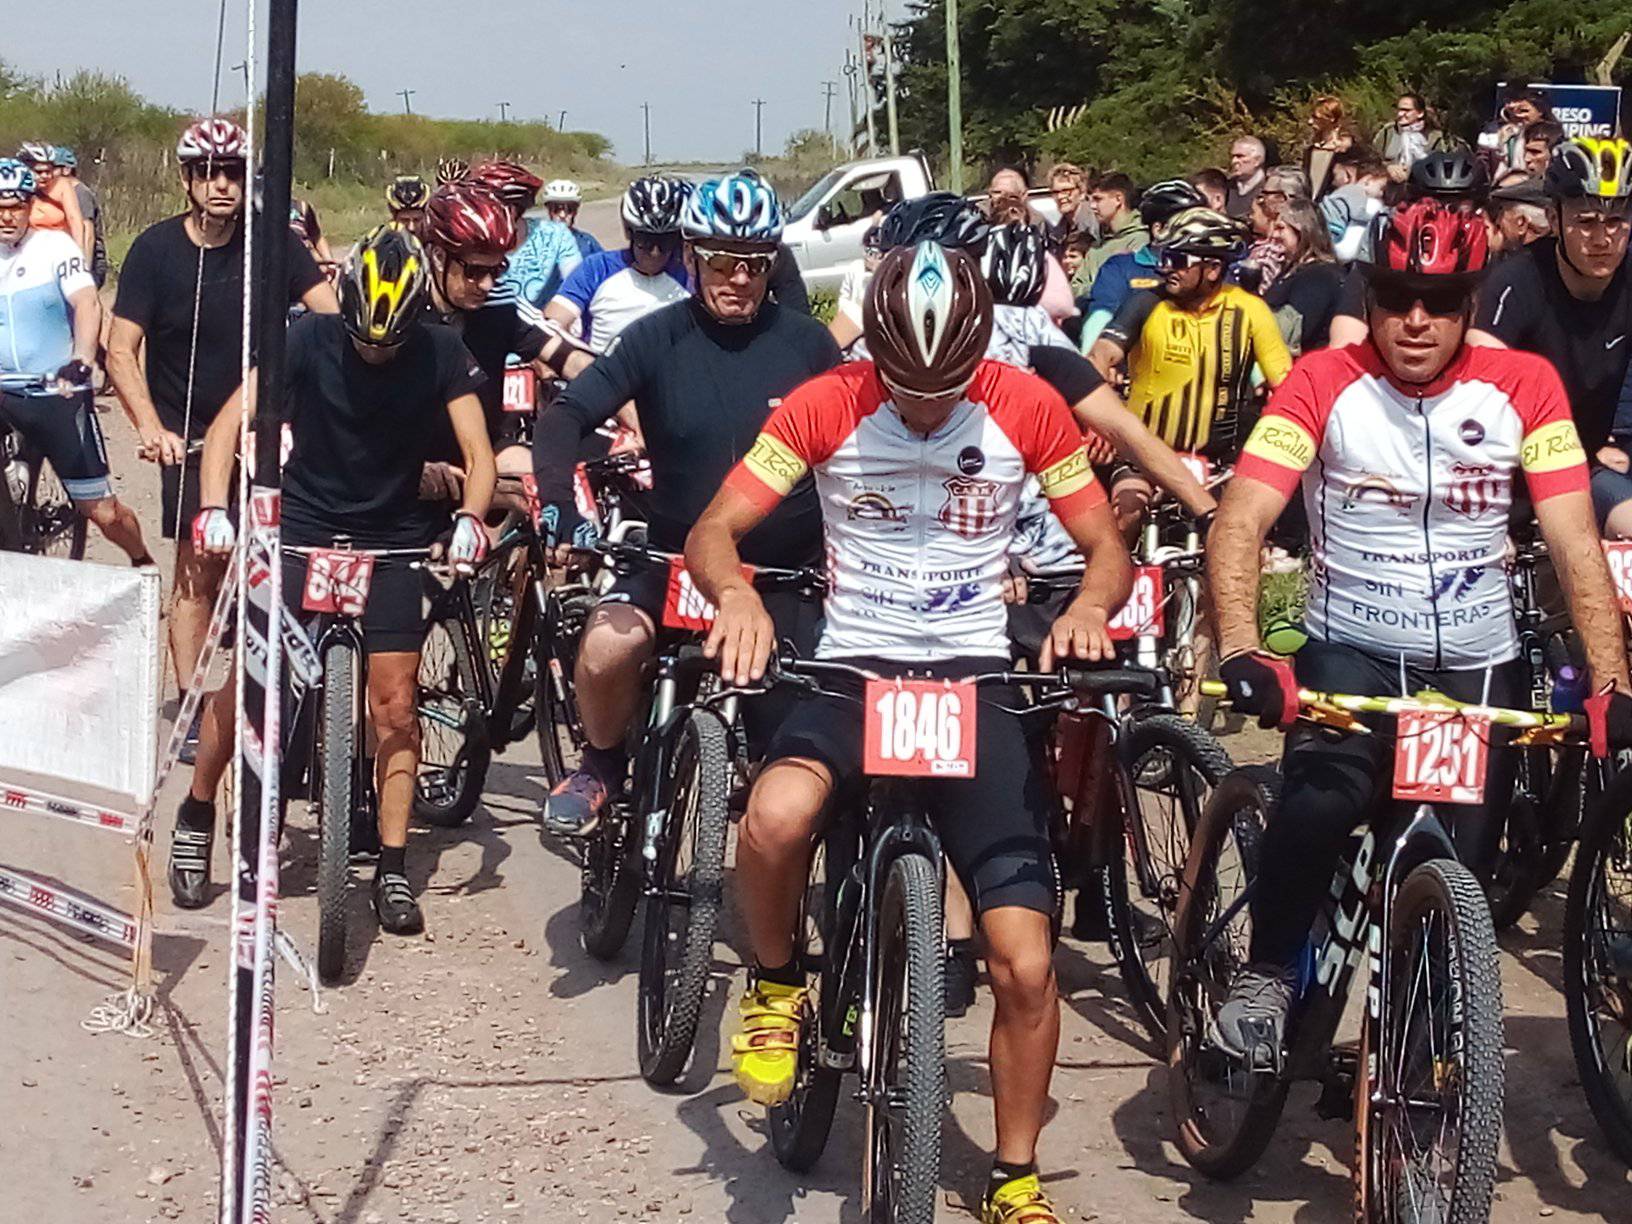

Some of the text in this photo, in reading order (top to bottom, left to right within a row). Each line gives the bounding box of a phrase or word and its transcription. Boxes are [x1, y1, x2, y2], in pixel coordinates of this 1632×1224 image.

[1361, 544, 1492, 564] TRANSPORTE
[876, 690, 961, 761] 1846
[1401, 719, 1480, 787] 1251
